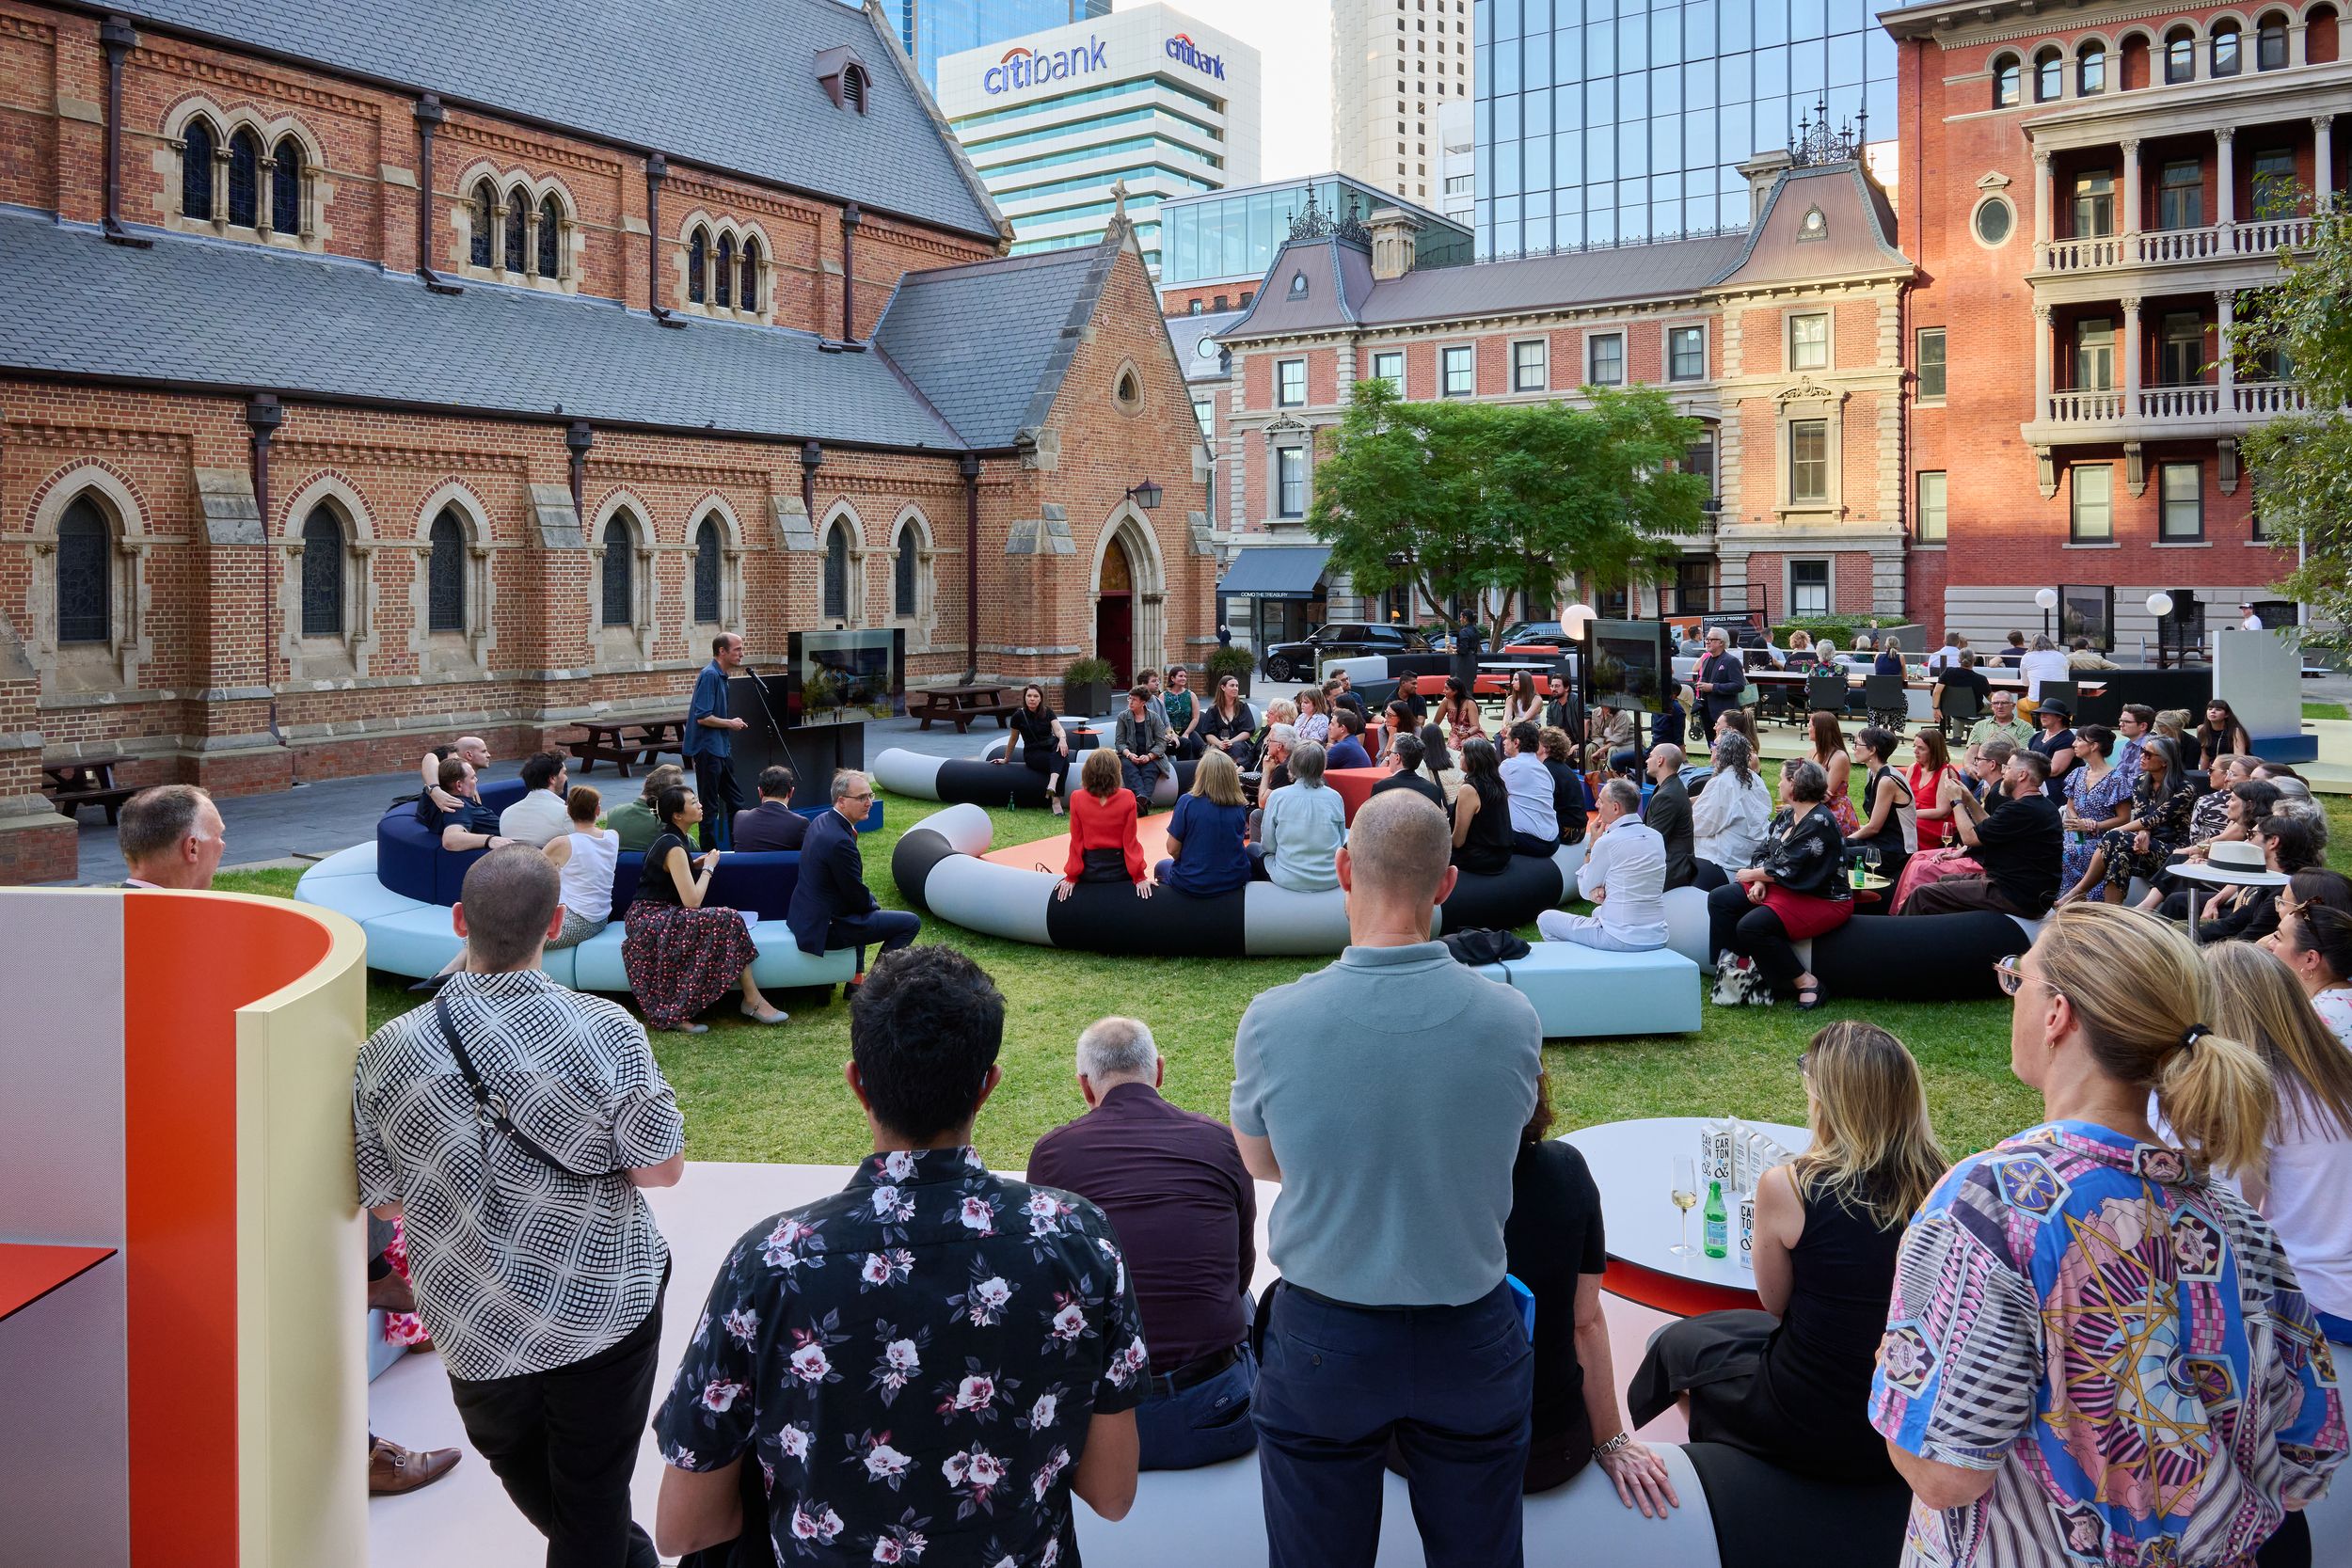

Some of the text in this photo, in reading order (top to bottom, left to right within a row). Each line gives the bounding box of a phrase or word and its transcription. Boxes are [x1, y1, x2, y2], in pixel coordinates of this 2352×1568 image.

[984, 34, 1107, 95] citibank
[1166, 34, 1226, 81] citibank
[1702, 1133, 1712, 1148] CAR
[1715, 1138, 1729, 1148] CAR
[1702, 1143, 1712, 1158] TON
[1715, 1148, 1729, 1159] TON
